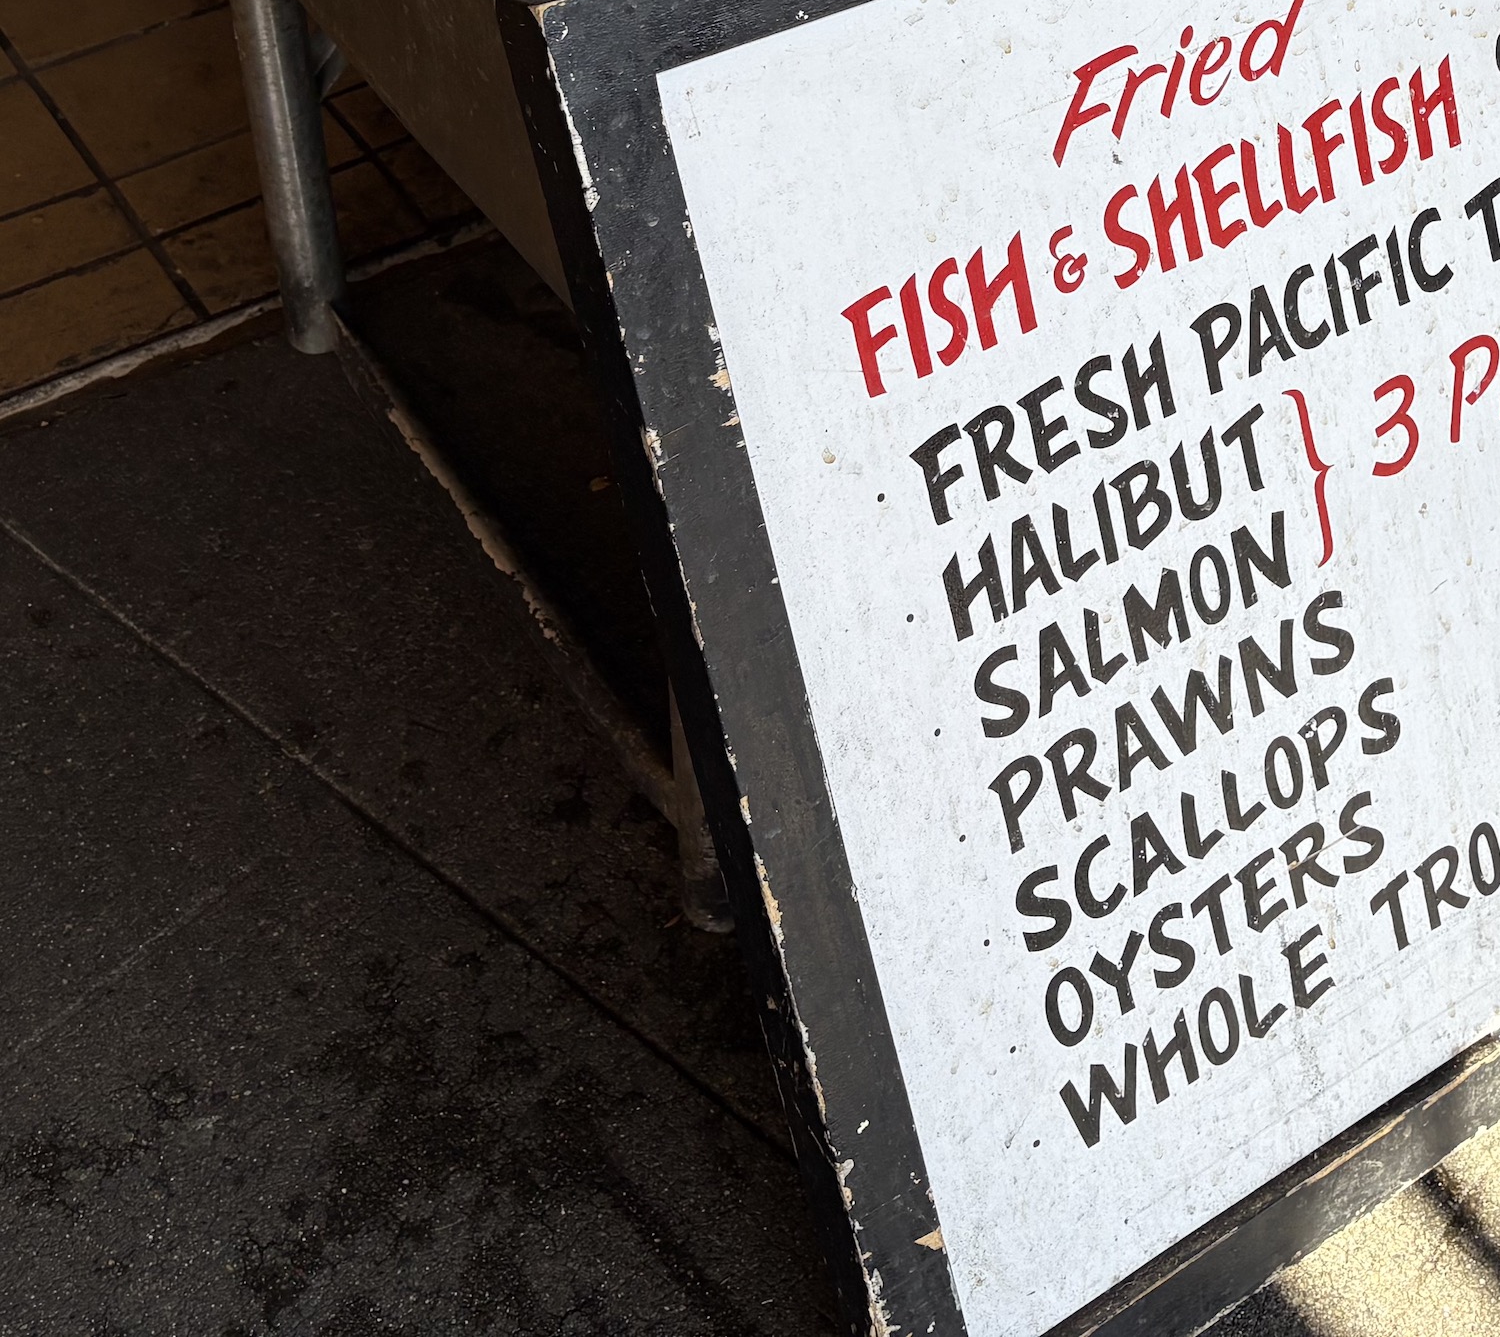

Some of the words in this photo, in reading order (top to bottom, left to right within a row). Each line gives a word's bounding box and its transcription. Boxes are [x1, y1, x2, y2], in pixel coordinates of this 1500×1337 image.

[840, 230, 1038, 399] FISH
[1048, 224, 1089, 294] &
[1103, 50, 1462, 293] SHELLFISH
[908, 331, 1177, 526] FRESH
[1189, 207, 1454, 396] PACIFIC
[1372, 374, 1420, 477] 3
[941, 403, 1265, 642] HALIBUT
[973, 510, 1292, 739] SALMON
[987, 590, 1355, 860] PRAWNS
[1015, 677, 1401, 956] SCALLOPS
[1044, 790, 1385, 1048] OYSTERS
[1058, 924, 1336, 1149] WHOLE
